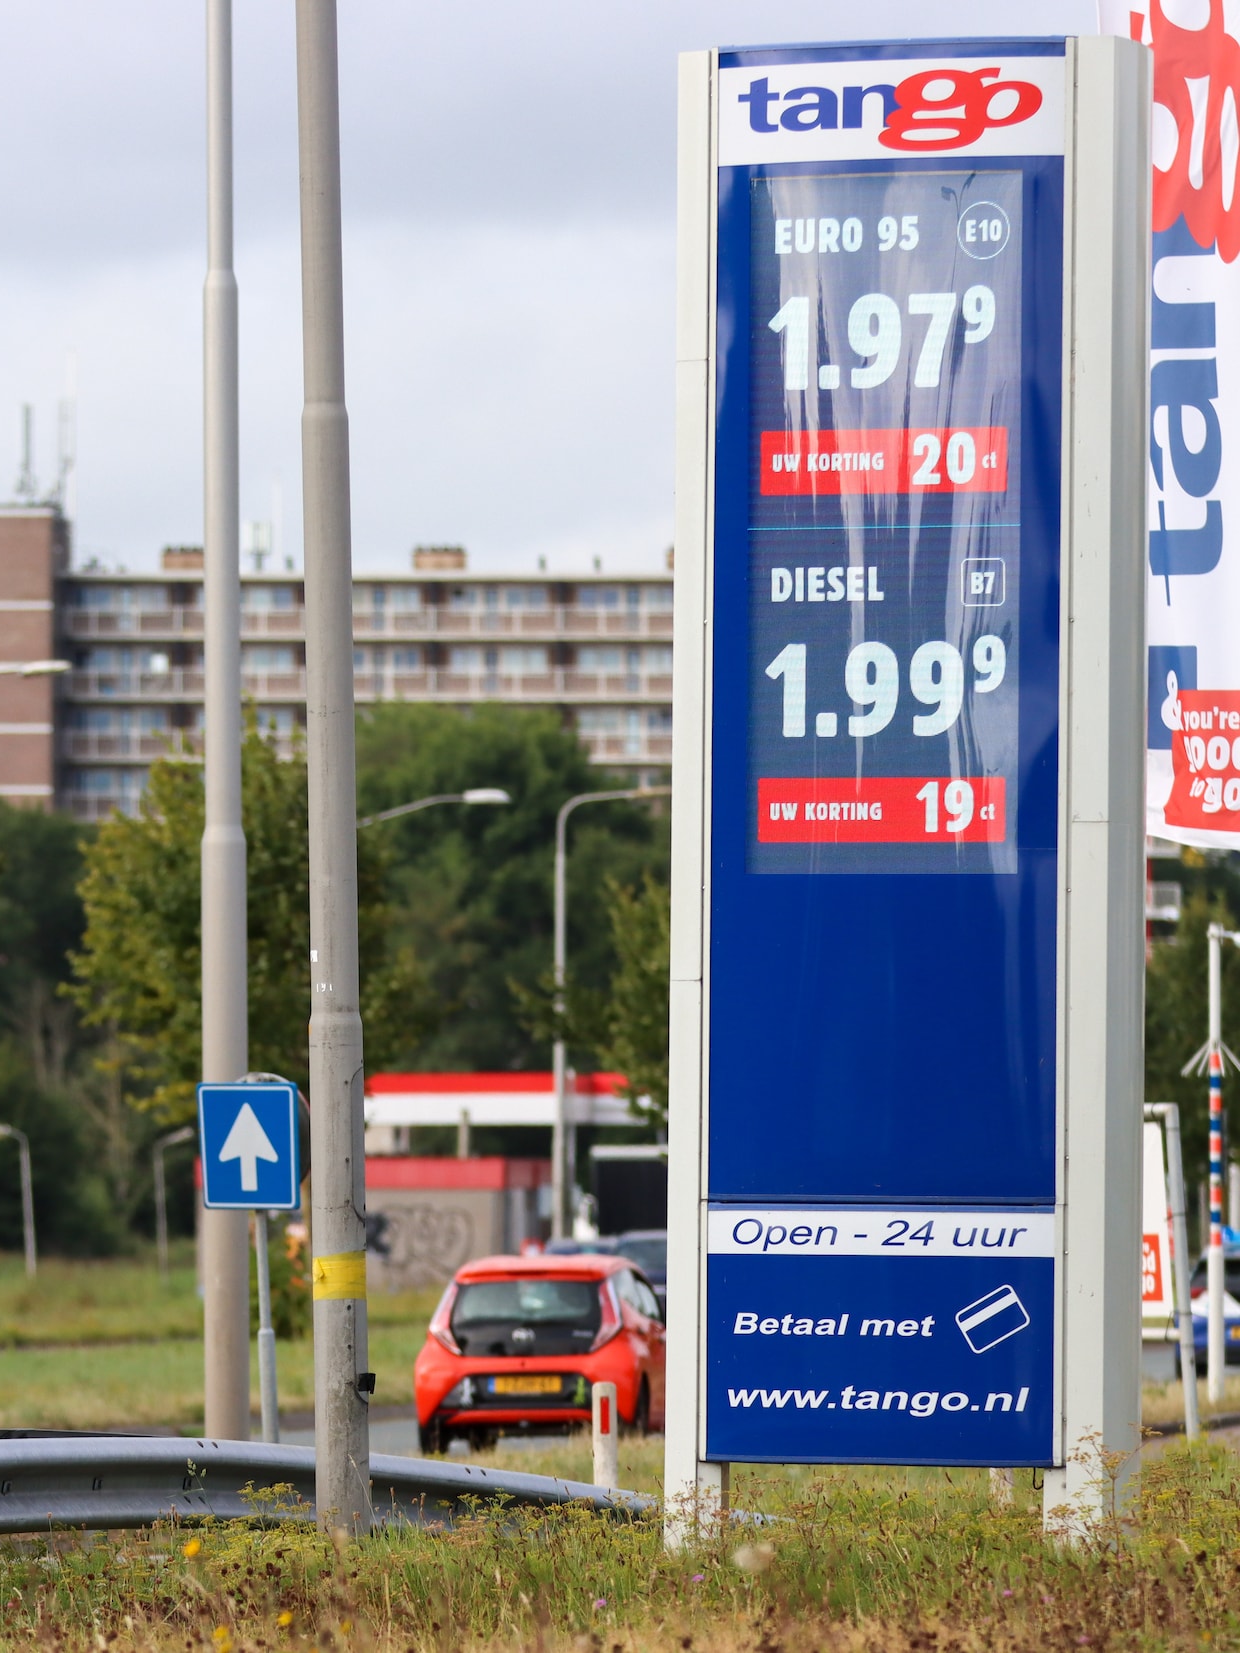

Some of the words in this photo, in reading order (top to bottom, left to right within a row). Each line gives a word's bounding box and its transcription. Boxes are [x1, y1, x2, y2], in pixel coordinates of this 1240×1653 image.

[737, 66, 1043, 152] tango
[773, 217, 863, 255] EURO
[877, 215, 920, 252] 95
[965, 218, 1002, 243] E10
[771, 453, 801, 473] UW
[807, 451, 885, 473] KORTING
[912, 432, 976, 486] 20
[981, 450, 998, 470] ct
[771, 566, 885, 602] DIESEL
[970, 571, 996, 595] B7
[769, 802, 797, 821] UW
[805, 802, 883, 822] KORTING
[915, 780, 975, 834] 19
[979, 801, 996, 821] ct
[732, 1218, 838, 1252] Open
[880, 1219, 935, 1247] 24
[952, 1225, 1028, 1248] uur
[733, 1312, 849, 1336] Betaal
[859, 1315, 935, 1337] met
[727, 1385, 1030, 1417] www.tango.nl
